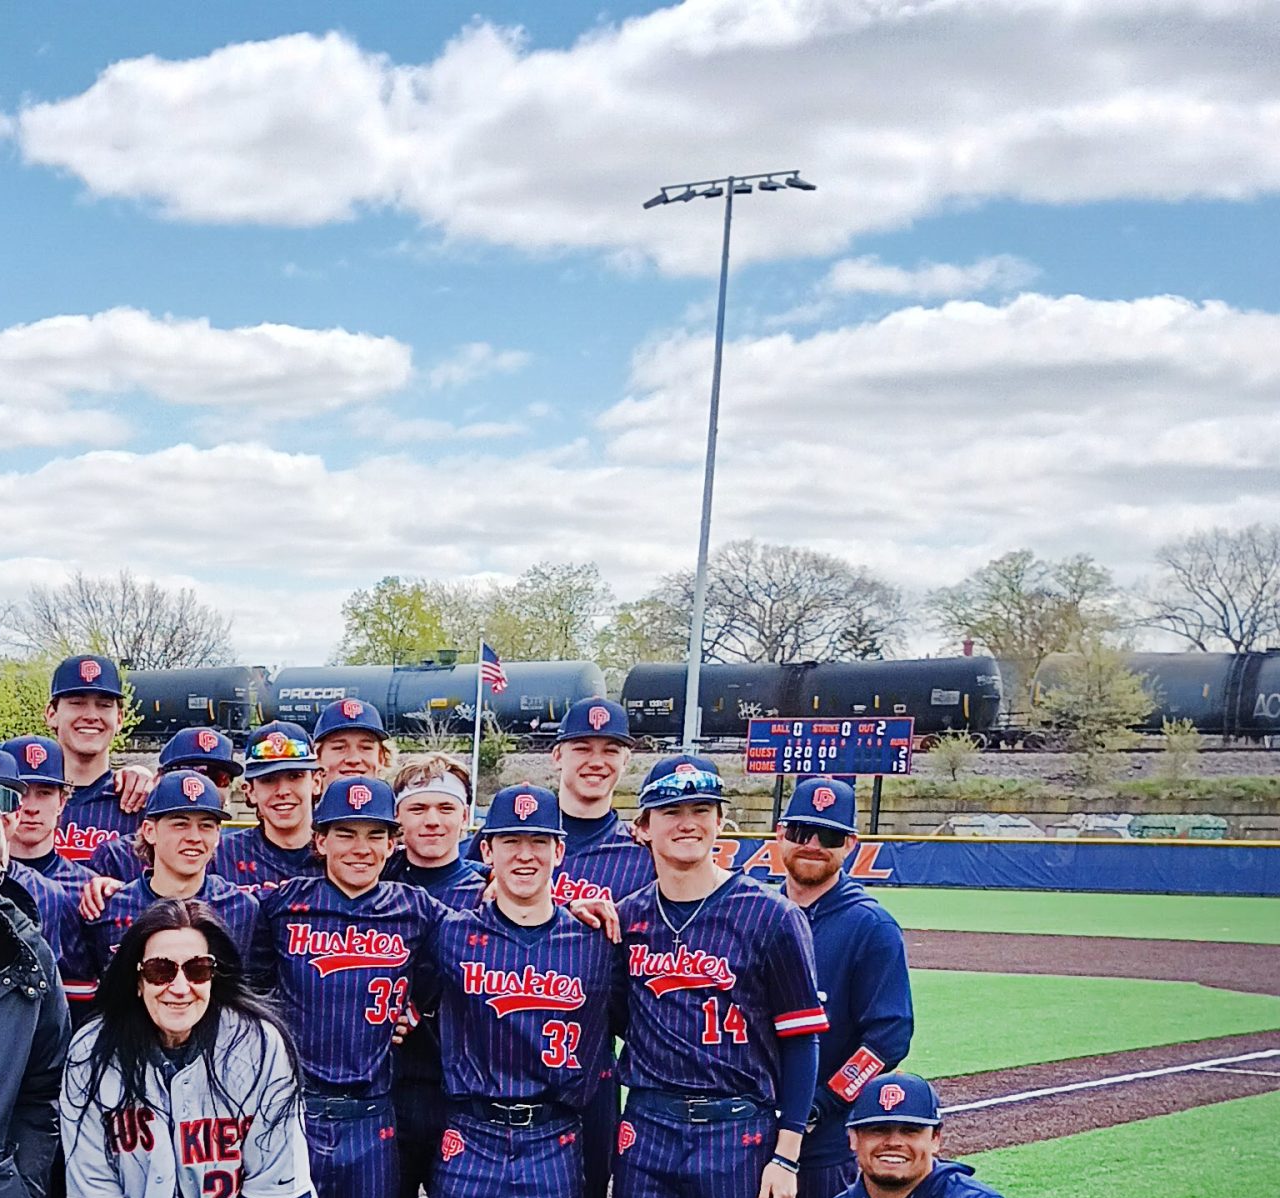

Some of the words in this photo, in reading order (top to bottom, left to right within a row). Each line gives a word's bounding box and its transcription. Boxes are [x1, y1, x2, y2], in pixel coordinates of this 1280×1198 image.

[771, 723, 790, 734] BALL
[793, 721, 803, 736] 0
[812, 723, 840, 734] STRIKE
[841, 721, 852, 736] 0
[858, 723, 875, 734] OUT
[876, 720, 887, 736] 2
[749, 747, 777, 758] GUEST
[898, 746, 908, 759] 2
[749, 761, 776, 771] HOME
[892, 761, 907, 773] 13
[287, 923, 410, 956] Huskies
[629, 944, 736, 981] Huskies
[460, 961, 586, 998] Huskies
[702, 997, 749, 1044] 14
